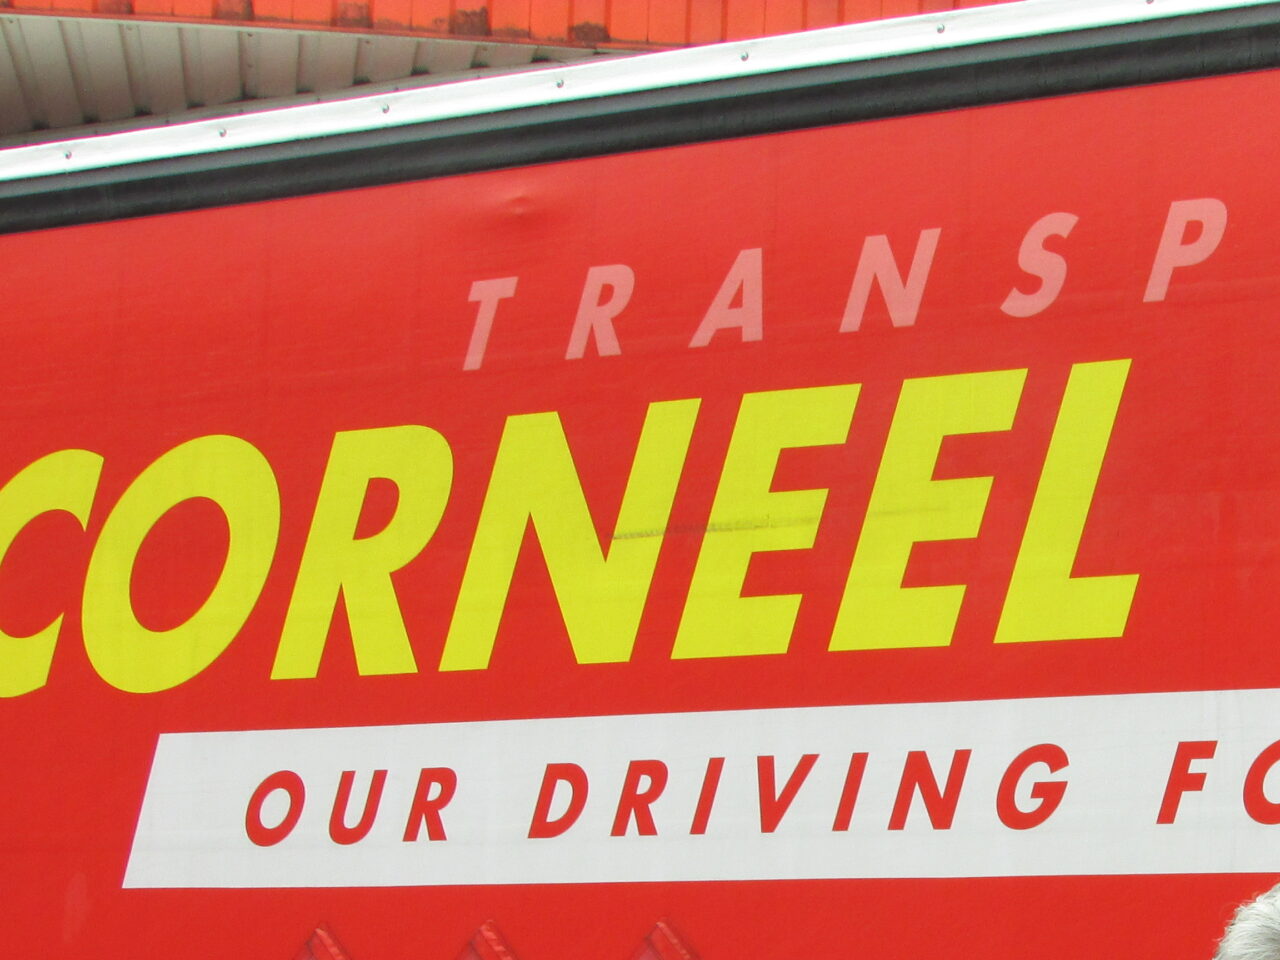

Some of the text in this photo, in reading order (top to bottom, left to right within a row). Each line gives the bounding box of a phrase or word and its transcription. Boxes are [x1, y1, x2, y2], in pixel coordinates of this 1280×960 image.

[0, 384, 1139, 697] CORNEEL
[246, 768, 457, 846] OUR
[528, 744, 1068, 838] DRIVING
